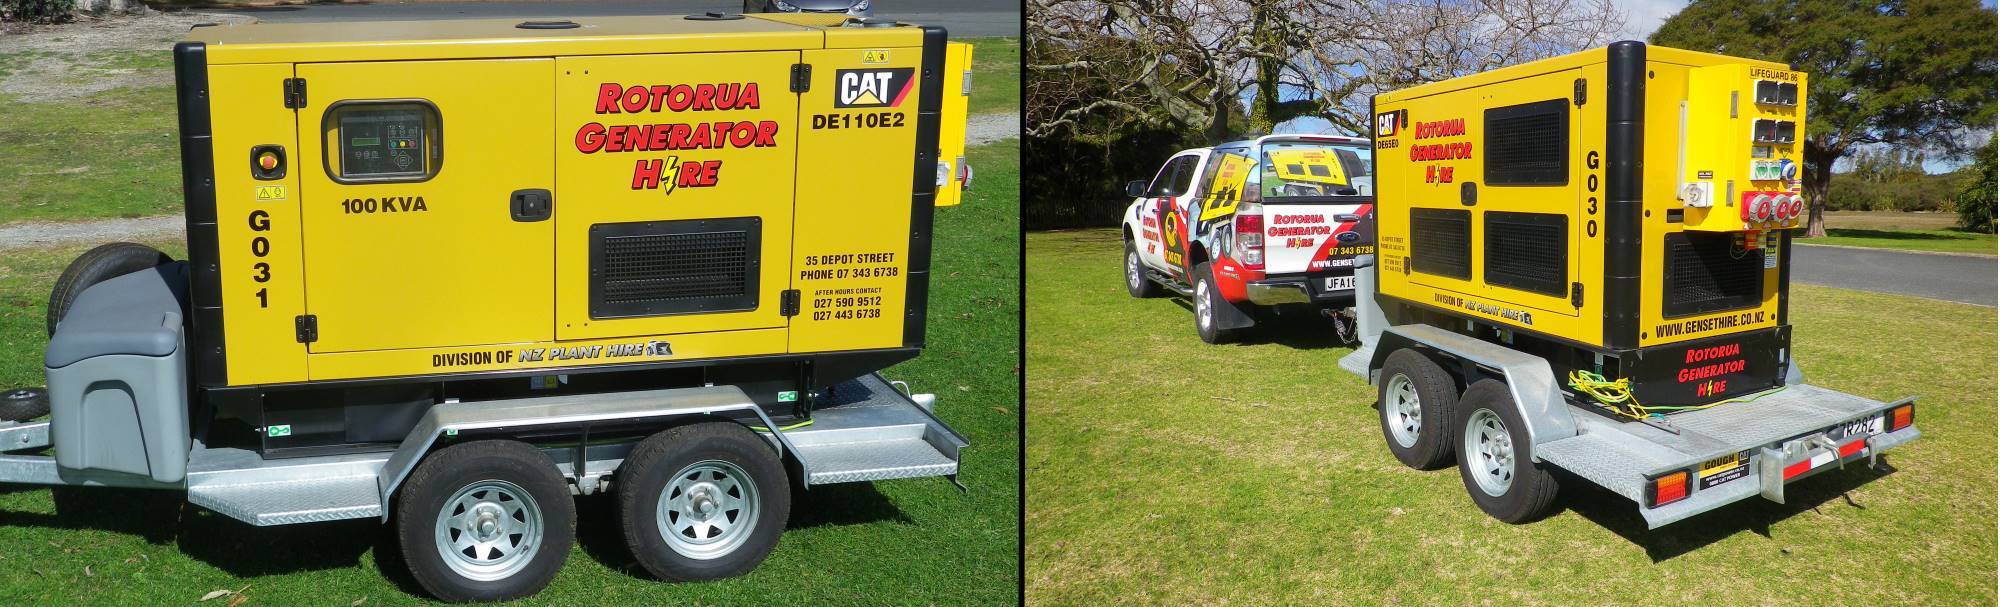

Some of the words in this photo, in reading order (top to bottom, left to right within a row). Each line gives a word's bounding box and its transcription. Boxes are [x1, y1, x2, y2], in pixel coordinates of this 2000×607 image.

[1750, 68, 1789, 81] LIFEGUARD
[1790, 73, 1798, 82] 86
[595, 82, 760, 114] ROTORUA
[841, 71, 892, 105] CAT
[812, 112, 905, 130] DE110E2
[1378, 113, 1394, 136] CAT
[1415, 118, 1466, 140] ROTORUA
[574, 121, 779, 154] GENERATOR
[1409, 142, 1473, 162] GENERATOR
[1587, 150, 1599, 238] G030
[341, 198, 377, 214] 100
[381, 196, 428, 213] KVA
[1273, 214, 1325, 225] ROTORUA
[1267, 226, 1331, 237] GENERATOR
[248, 210, 271, 308] G031
[805, 255, 818, 266] 35
[821, 254, 854, 265] DEPOT
[857, 252, 895, 264] STREET
[1329, 247, 1338, 256] 07
[1340, 247, 1354, 255] 343
[800, 269, 834, 280] PHONE
[836, 269, 849, 279] 07
[852, 268, 871, 278] 343
[873, 267, 898, 277] 6738
[855, 287, 882, 295] CONTACT
[814, 299, 832, 309] 027
[835, 298, 854, 307] 590
[857, 297, 881, 307] 9512
[1434, 292, 1456, 307] DIVISION
[1456, 298, 1464, 308] OF
[1477, 303, 1500, 316] PLANT
[1501, 308, 1519, 321] HIRE
[813, 311, 832, 321] 027
[835, 310, 853, 320] 443
[856, 309, 881, 319] 6738
[1656, 311, 1765, 338] WWW.GENSETHIRE.CO.NZ
[432, 352, 492, 367] DIVISION
[496, 350, 513, 364] OF
[518, 348, 546, 363] NZ
[548, 345, 603, 361] PLANT
[605, 343, 644, 357] HIRE
[1685, 343, 1741, 364] ROTORUA
[1677, 359, 1746, 383] GENERATOR
[1704, 453, 1735, 470] GOUGH
